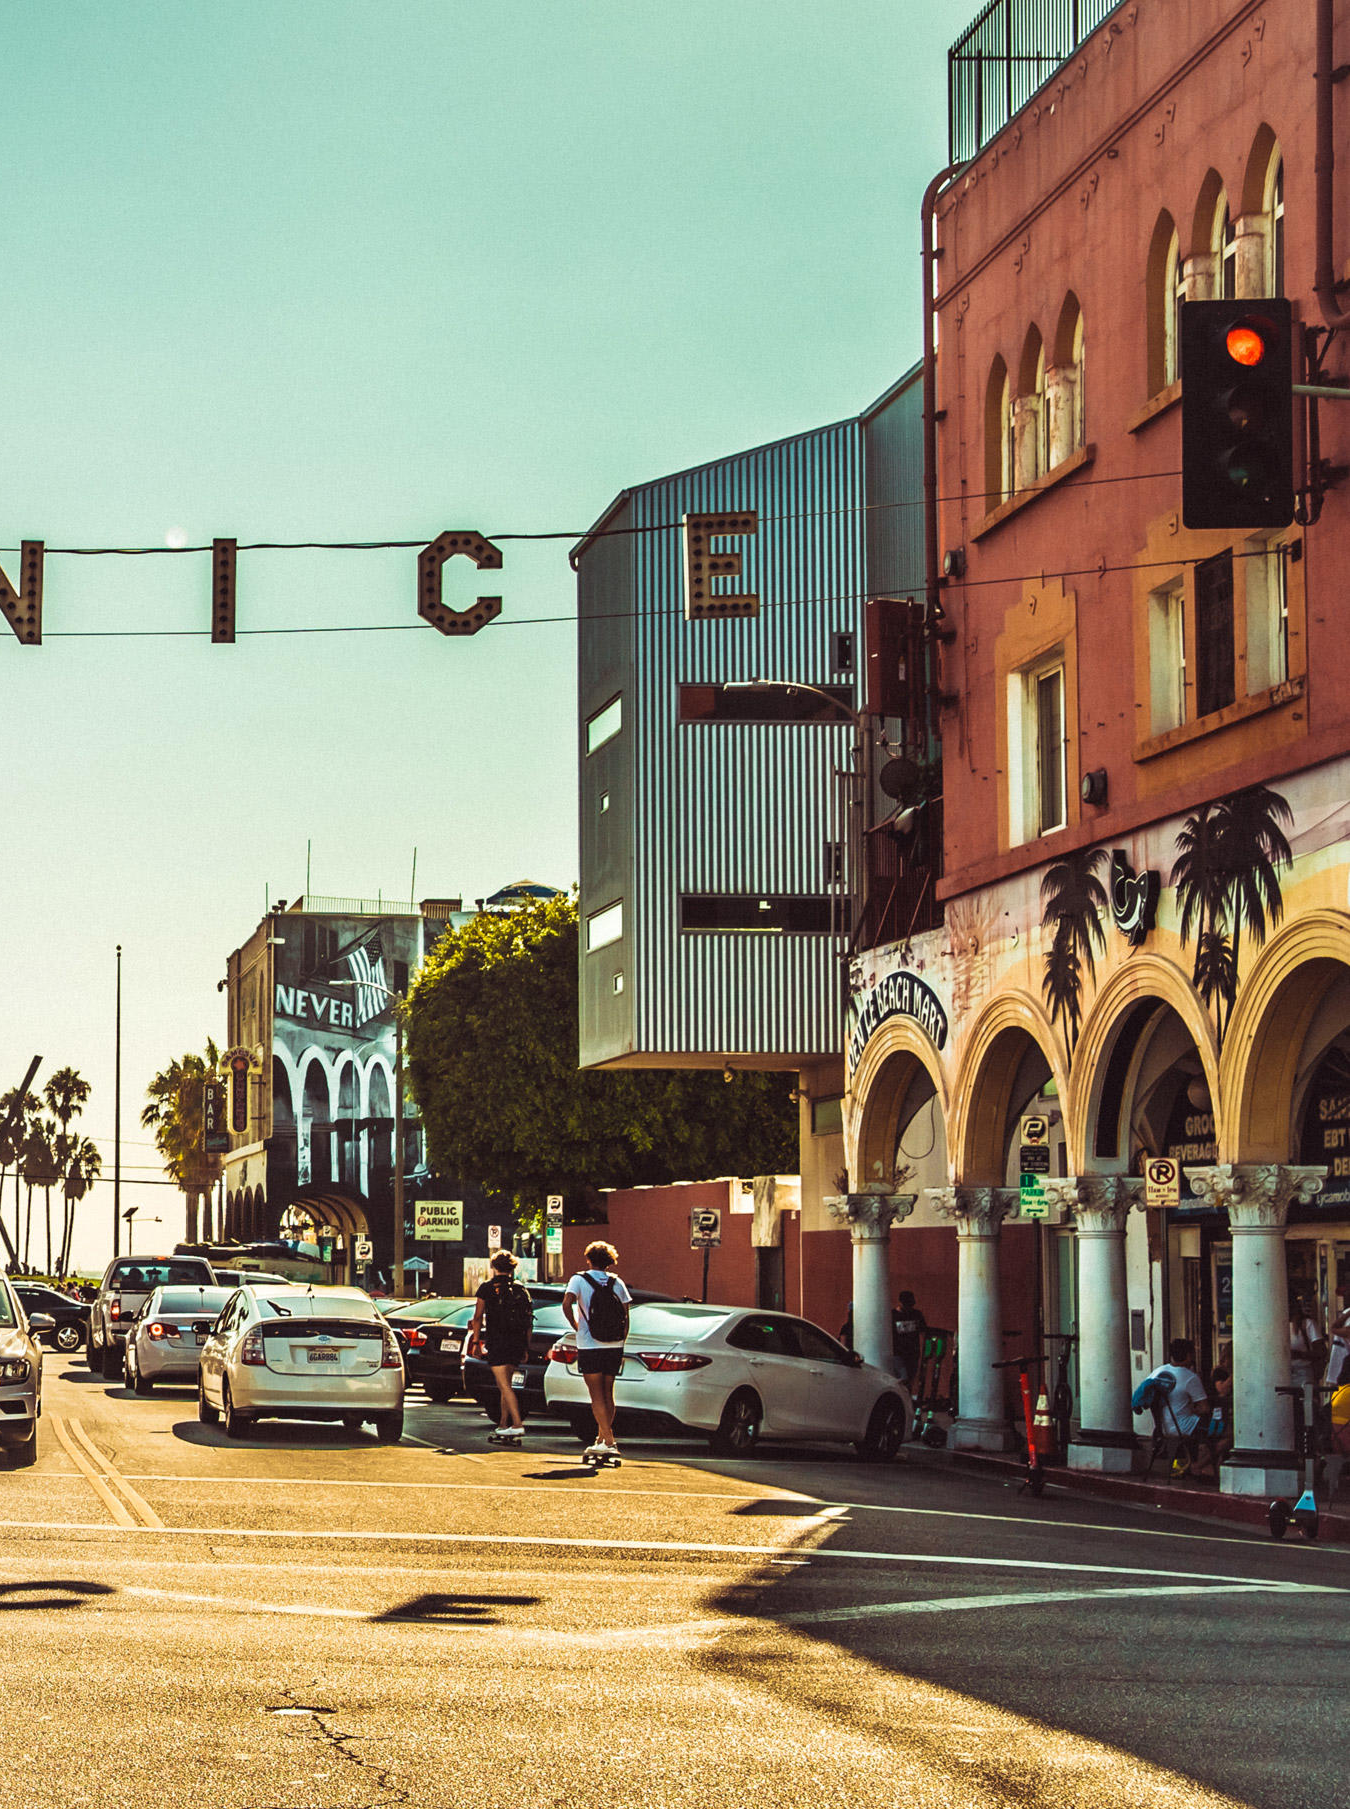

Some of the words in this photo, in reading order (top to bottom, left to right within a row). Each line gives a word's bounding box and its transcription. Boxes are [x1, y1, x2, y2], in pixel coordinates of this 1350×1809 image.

[275, 984, 354, 1028] NEVER
[876, 976, 910, 1018] BEACH
[913, 983, 944, 1050] MART
[206, 1088, 215, 1130] BAR
[1324, 1128, 1346, 1149] EBT
[1169, 1142, 1218, 1161] BEVERAGE
[1022, 1188, 1045, 1197] PARKIN
[420, 1206, 457, 1216] PUBLIC
[417, 1216, 460, 1227] PARKING
